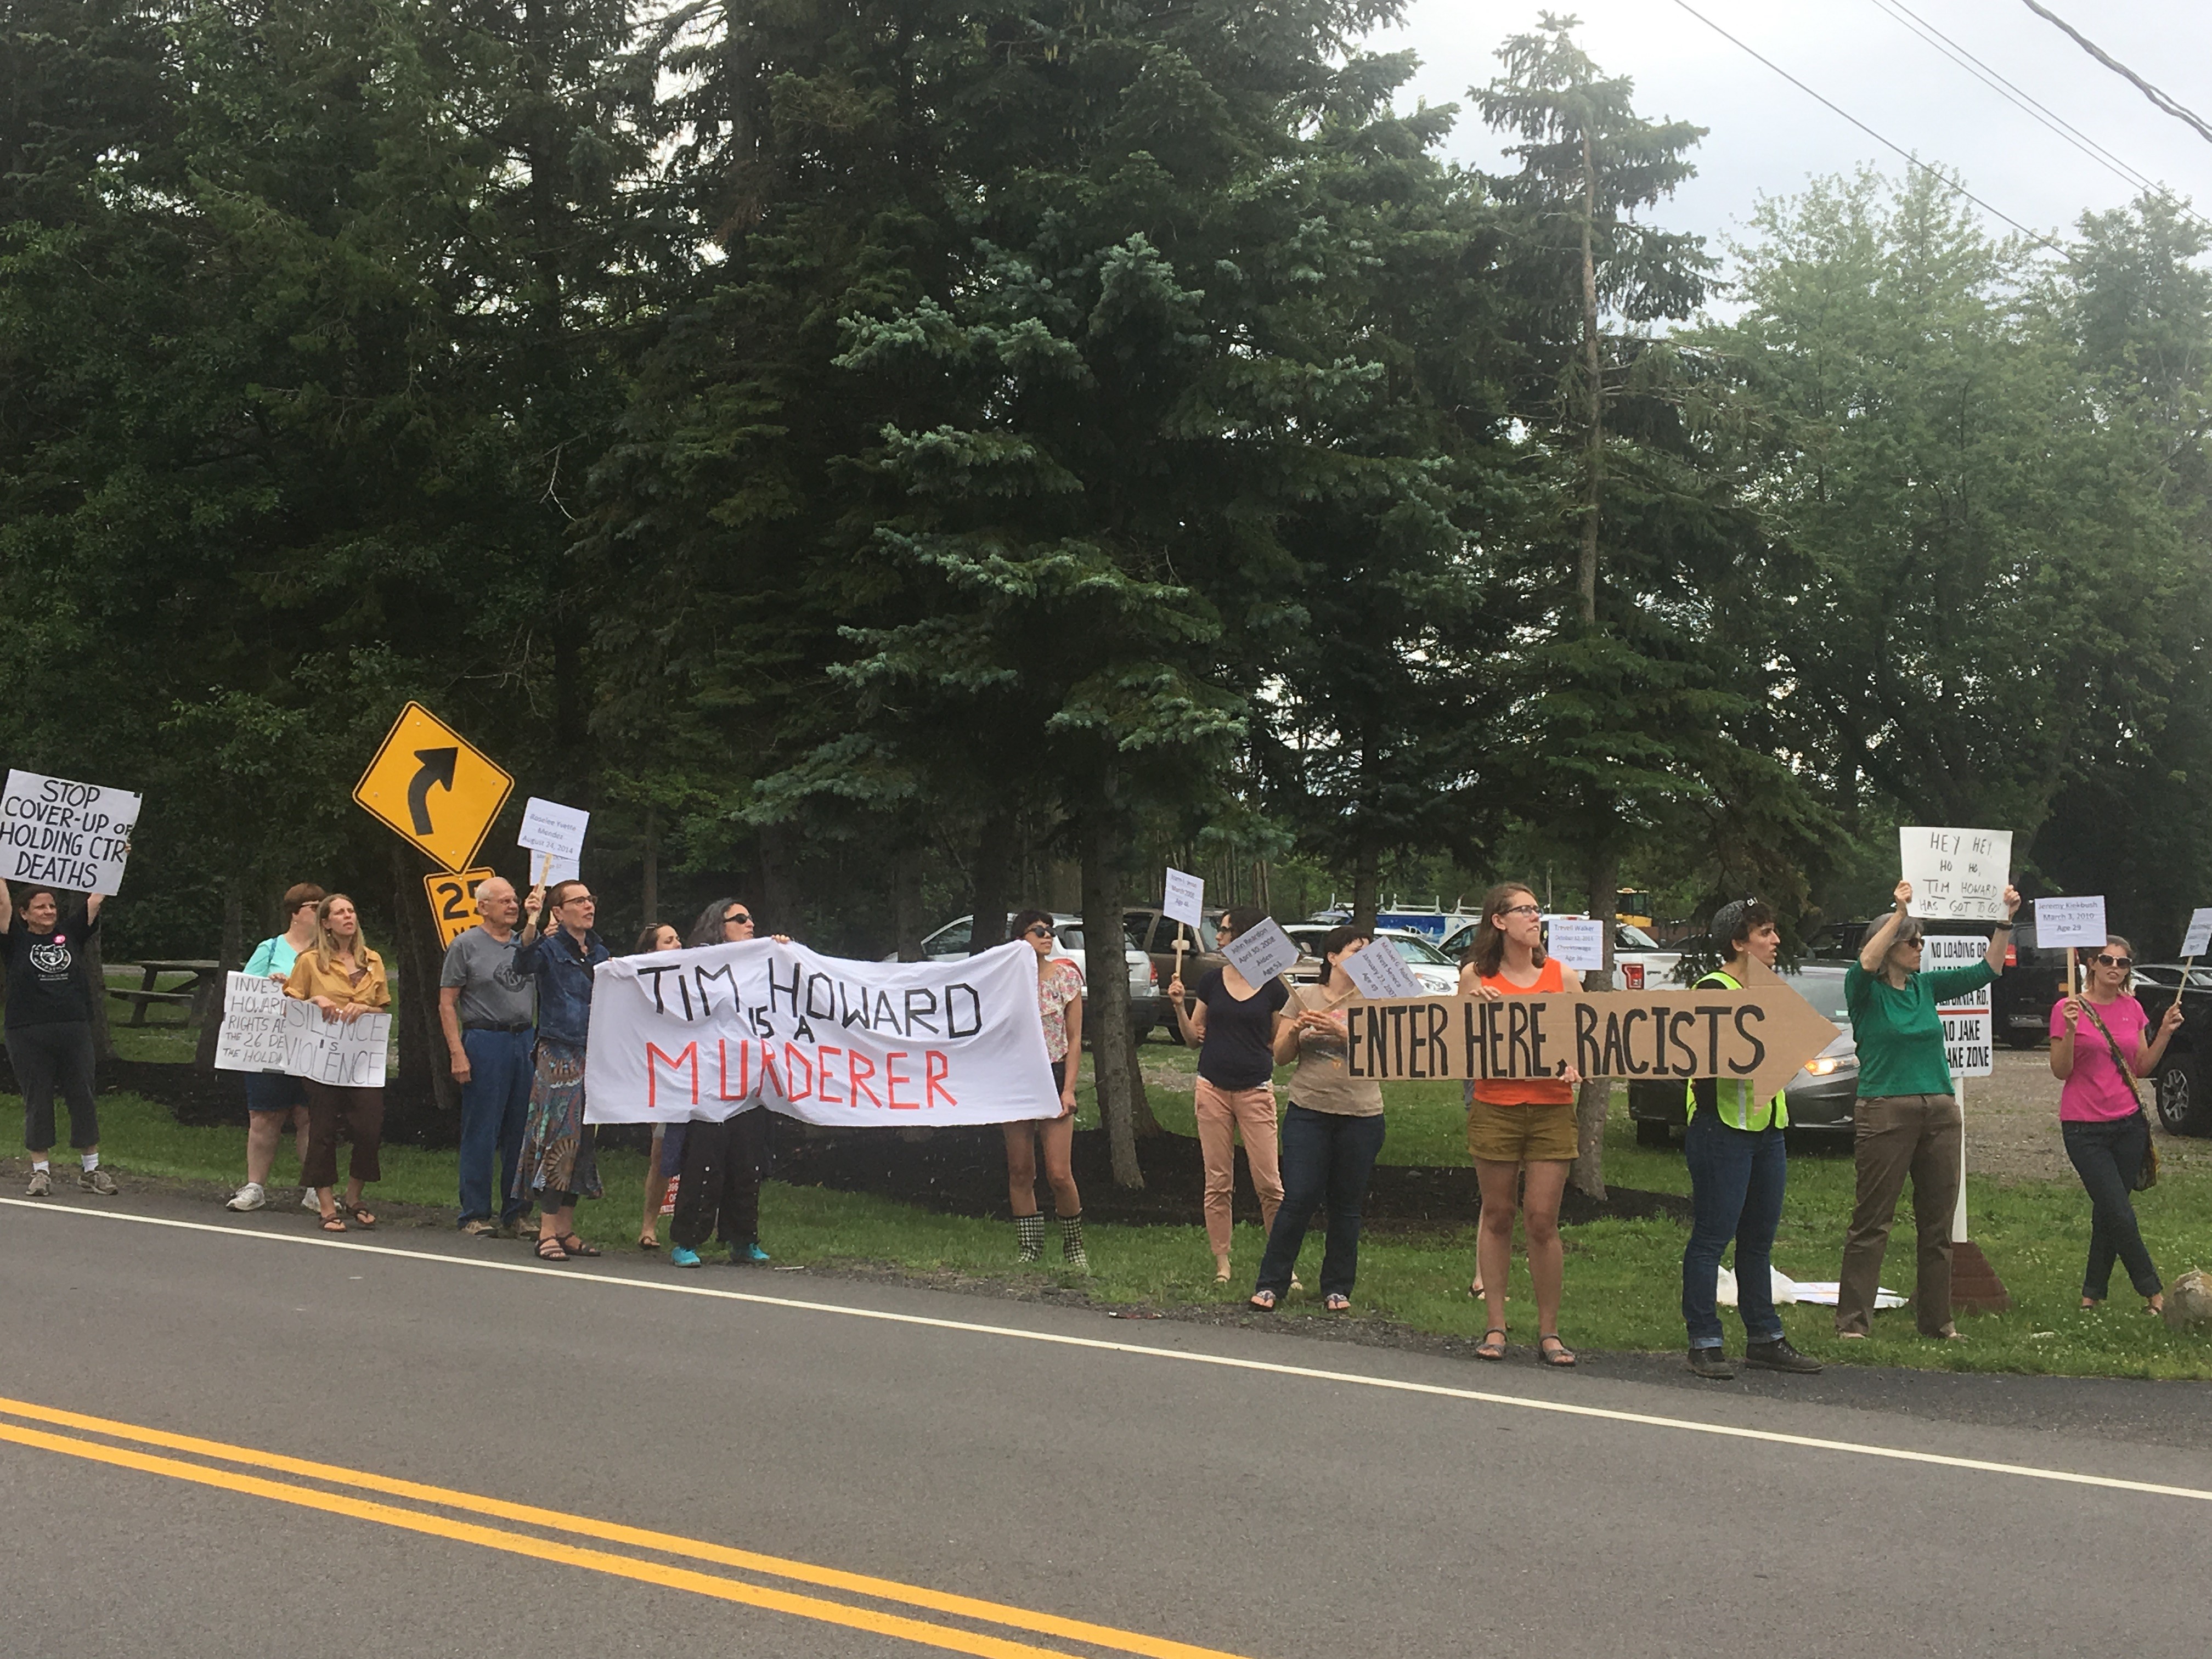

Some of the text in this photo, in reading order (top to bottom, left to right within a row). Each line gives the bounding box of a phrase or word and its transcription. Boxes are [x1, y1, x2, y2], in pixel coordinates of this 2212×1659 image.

[40, 780, 100, 809] STOP
[5, 796, 132, 835] COVER-UP OF
[0, 821, 126, 862] HOLDING CTR
[522, 836, 544, 846] August
[558, 844, 573, 854] 2014
[1931, 832, 1960, 855] HEY
[14, 851, 97, 888] DEATHS
[1940, 860, 1953, 871] HO
[1923, 879, 1997, 898] TIM HOWARD
[1920, 899, 1938, 911] HAS
[1949, 900, 1971, 912] GOT
[1977, 901, 1985, 913] TO
[1239, 951, 1252, 963] April
[1931, 942, 1987, 958] NO LOADING OR
[1262, 967, 1274, 976] Age
[1363, 953, 1379, 975] January
[1376, 952, 1401, 988] West Seneca
[235, 977, 280, 994] INVES
[1362, 973, 1372, 983] Age
[637, 957, 982, 1039] TIM HOWARD
[228, 1015, 269, 1031] RIGHTS
[288, 1000, 387, 1042] SILENCE
[749, 1007, 815, 1043] IS A
[1959, 1020, 1980, 1041] JAKE
[244, 1032, 262, 1047] 26
[269, 1035, 284, 1048] DE
[320, 1039, 338, 1051] IS
[1348, 1001, 1765, 1078] ENTER HERE, RACISTS
[223, 1048, 241, 1057] THE
[285, 1035, 383, 1085] VIOLENCE
[1947, 1046, 1989, 1068] AKE ZONE
[646, 1039, 958, 1109] MURDERER
